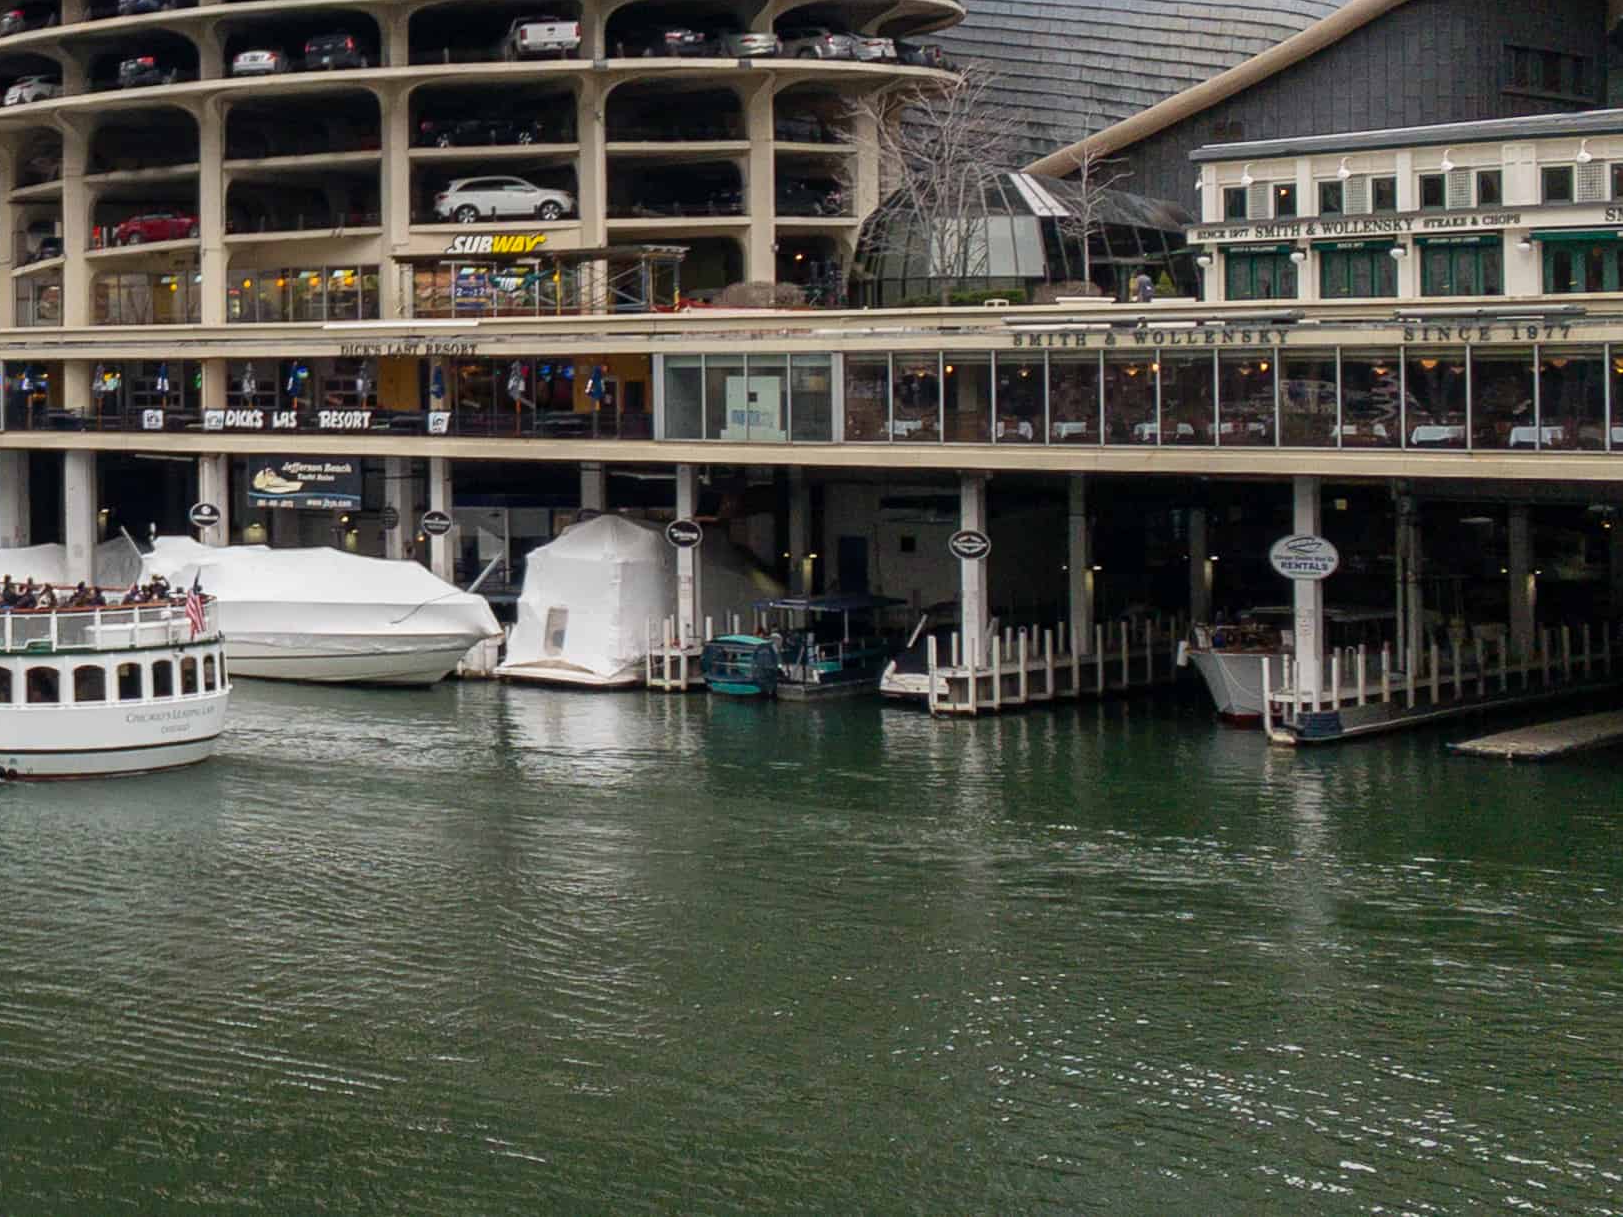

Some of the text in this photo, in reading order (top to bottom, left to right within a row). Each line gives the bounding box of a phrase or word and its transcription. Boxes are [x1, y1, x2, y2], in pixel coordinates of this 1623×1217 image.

[1197, 229, 1225, 240] SINCE
[1254, 223, 1300, 238] SMITH
[1306, 223, 1316, 235] &
[1321, 217, 1414, 234] WOLLENSKY
[1470, 215, 1477, 225] &
[1482, 213, 1521, 225] CHOPS
[446, 234, 546, 254] SUBWAY
[1012, 330, 1289, 346] SMITH & WOLLENSKY
[1403, 325, 1572, 341] SINCE 1977
[341, 343, 477, 356] DICK'S LAST RESORT
[225, 410, 263, 427] DICK'S
[318, 410, 371, 428] RESORT
[281, 462, 352, 474] Jefferson Beach
[1281, 563, 1329, 571] RENTALS
